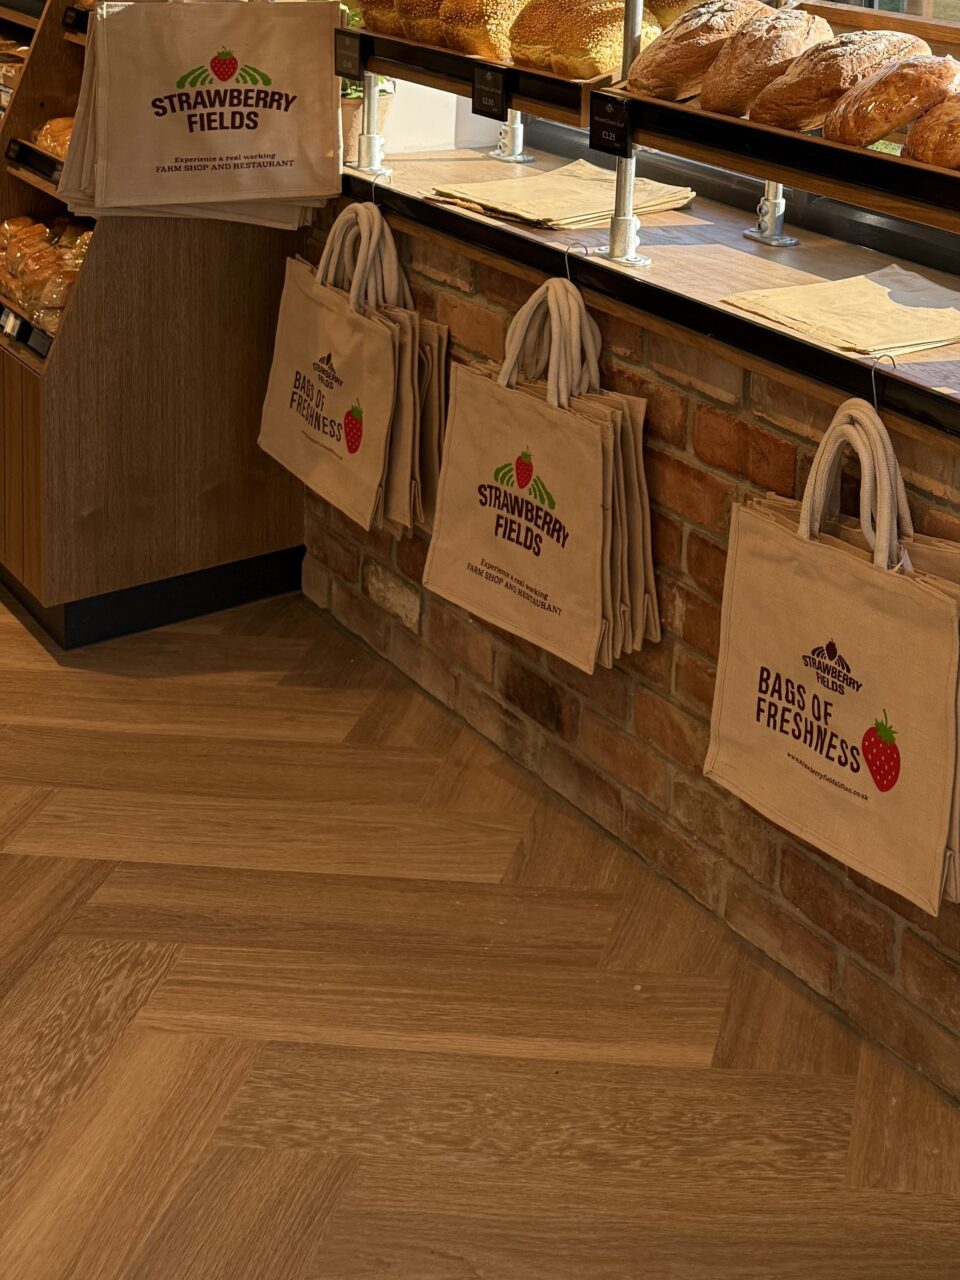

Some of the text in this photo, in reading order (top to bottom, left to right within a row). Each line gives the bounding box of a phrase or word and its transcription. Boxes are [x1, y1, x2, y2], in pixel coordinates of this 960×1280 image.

[151, 89, 297, 117] STRAWBERRY
[187, 111, 259, 133] FIELDS
[184, 164, 209, 172] SHOP
[233, 160, 295, 169] RESTAURANT
[293, 370, 326, 412] BAGS OF
[289, 391, 343, 442] FRESHNESS
[477, 483, 569, 549] STRAWBERRY
[494, 513, 543, 557] FIELDS
[466, 562, 484, 577] FARM
[484, 570, 504, 585] SHOP
[517, 588, 562, 616] RESTAURANT
[480, 558, 511, 579] Experience
[514, 577, 525, 587] real
[525, 583, 549, 601] working
[802, 654, 863, 693] STRAWBERRY
[816, 671, 846, 696] FIELDS
[758, 666, 834, 726] BAGS OF
[755, 696, 862, 774] FRESHNESS
